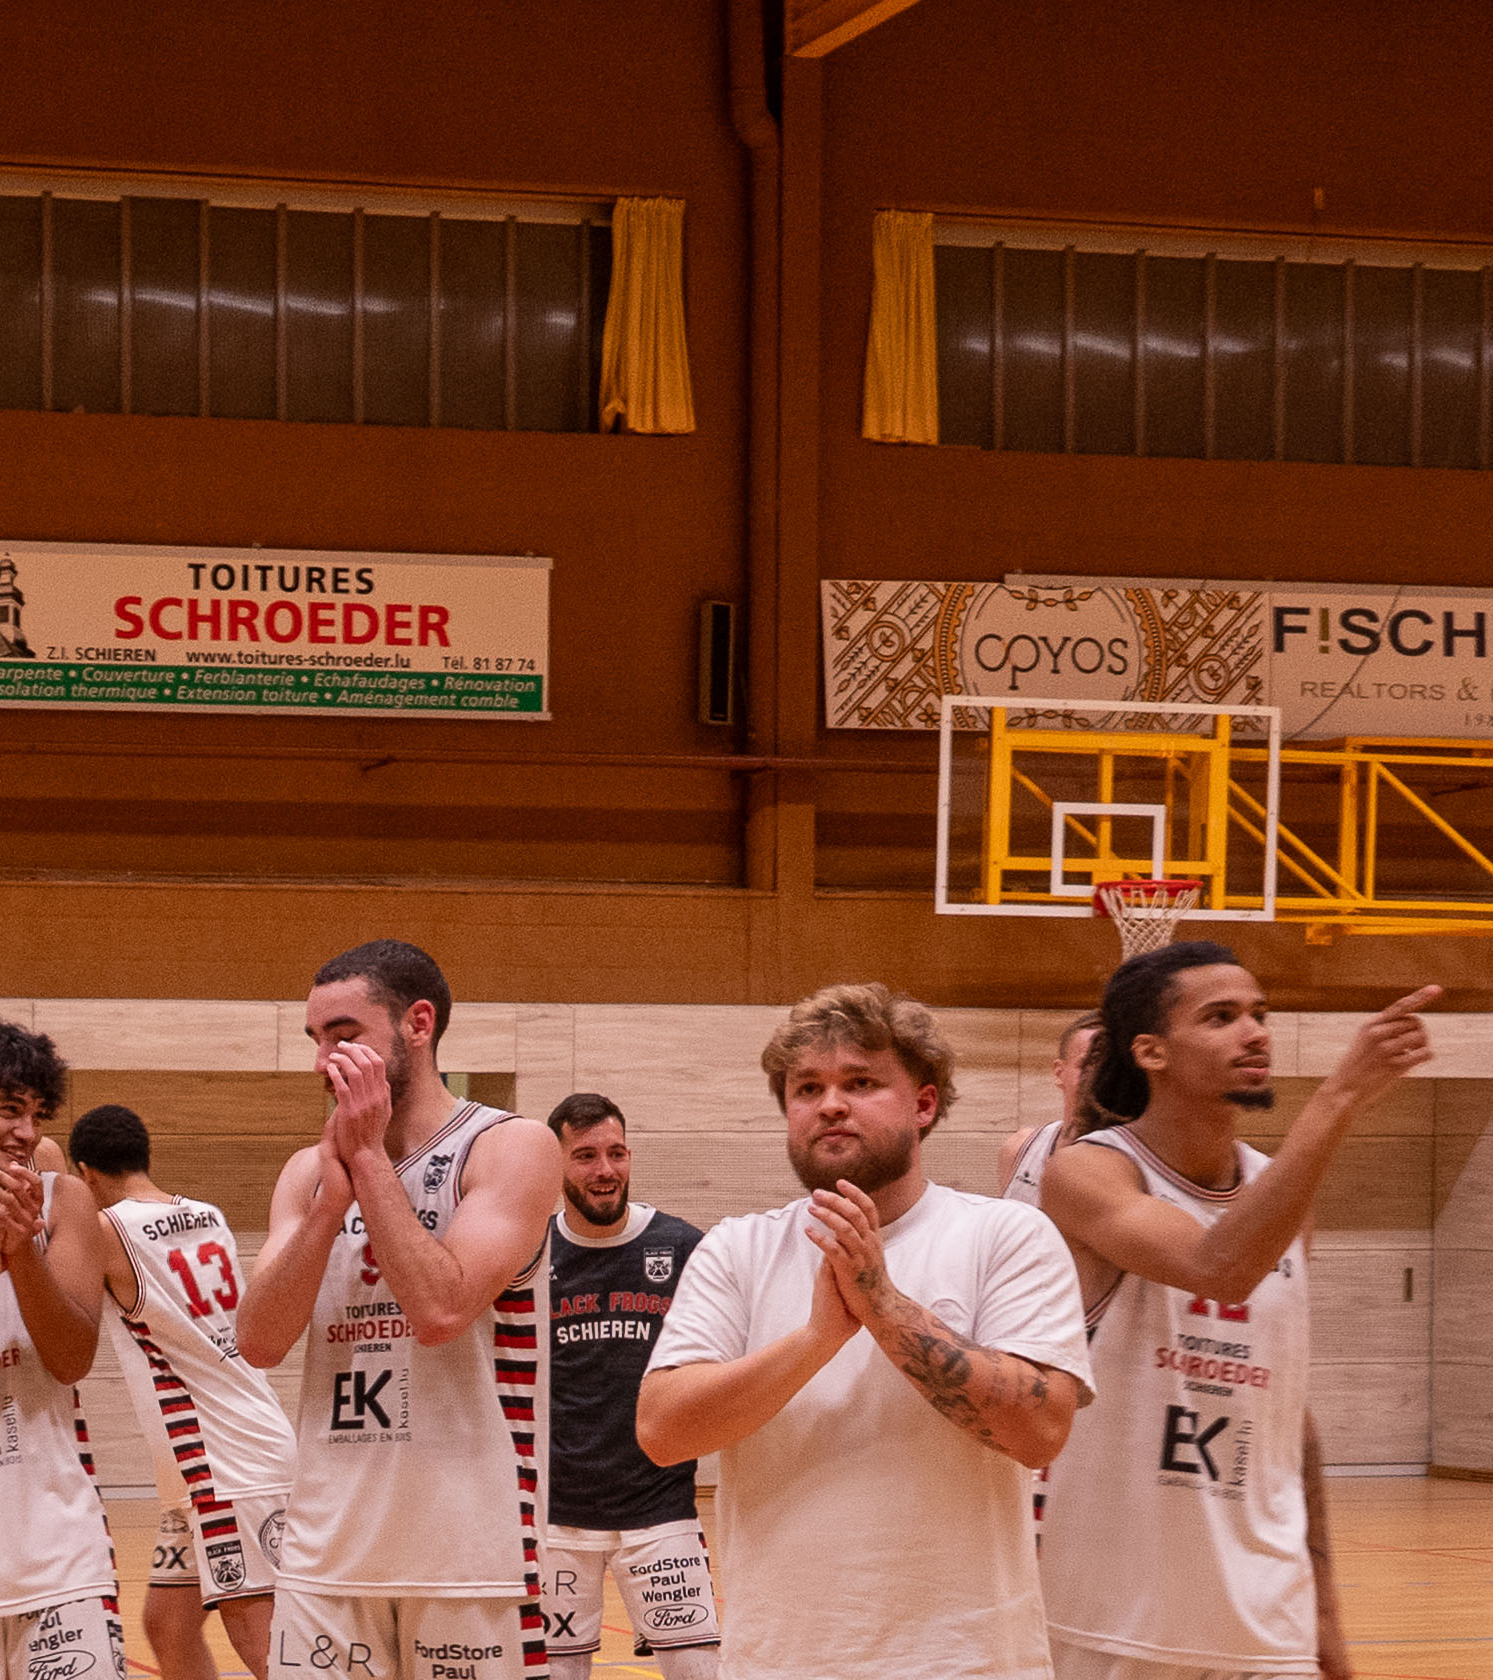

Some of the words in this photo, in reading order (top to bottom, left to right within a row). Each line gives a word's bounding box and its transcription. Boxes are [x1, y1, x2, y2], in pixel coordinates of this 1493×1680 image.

[188, 562, 375, 595] TOITURES
[114, 595, 451, 647] SCHROEDER
[75, 647, 156, 663] SCHIEREN
[186, 650, 411, 669] www.toitures-schroeder.lu
[443, 656, 467, 671] Tél.
[473, 657, 490, 671] 81
[495, 658, 513, 672] 87
[517, 658, 535, 672] 74
[82, 667, 175, 683] Couverture
[194, 669, 296, 686] Ferblanterie
[314, 673, 426, 692] Echafaudages
[444, 676, 536, 692] Rénovation
[1300, 681, 1446, 701] REALTORS
[1457, 677, 1479, 701] &
[71, 683, 158, 700] thermique
[177, 685, 256, 700] Extension
[263, 690, 319, 704] toiture
[336, 691, 457, 708] Aménagement
[460, 693, 519, 708] comble
[167, 1240, 239, 1319] 13
[345, 1302, 404, 1320] TOITURES
[609, 1290, 674, 1317] FROGS
[327, 1319, 415, 1343] SCHROED
[556, 1320, 651, 1344] SCHIEREN
[331, 1369, 393, 1431] EK
[399, 1368, 410, 1429] kasel.lu
[380, 1432, 393, 1443] EN
[629, 1556, 702, 1577] FordStore
[650, 1571, 686, 1588] Paul
[642, 1586, 702, 1603] Wengler
[653, 1607, 696, 1627] Ford
[431, 1664, 477, 1680] Paul
